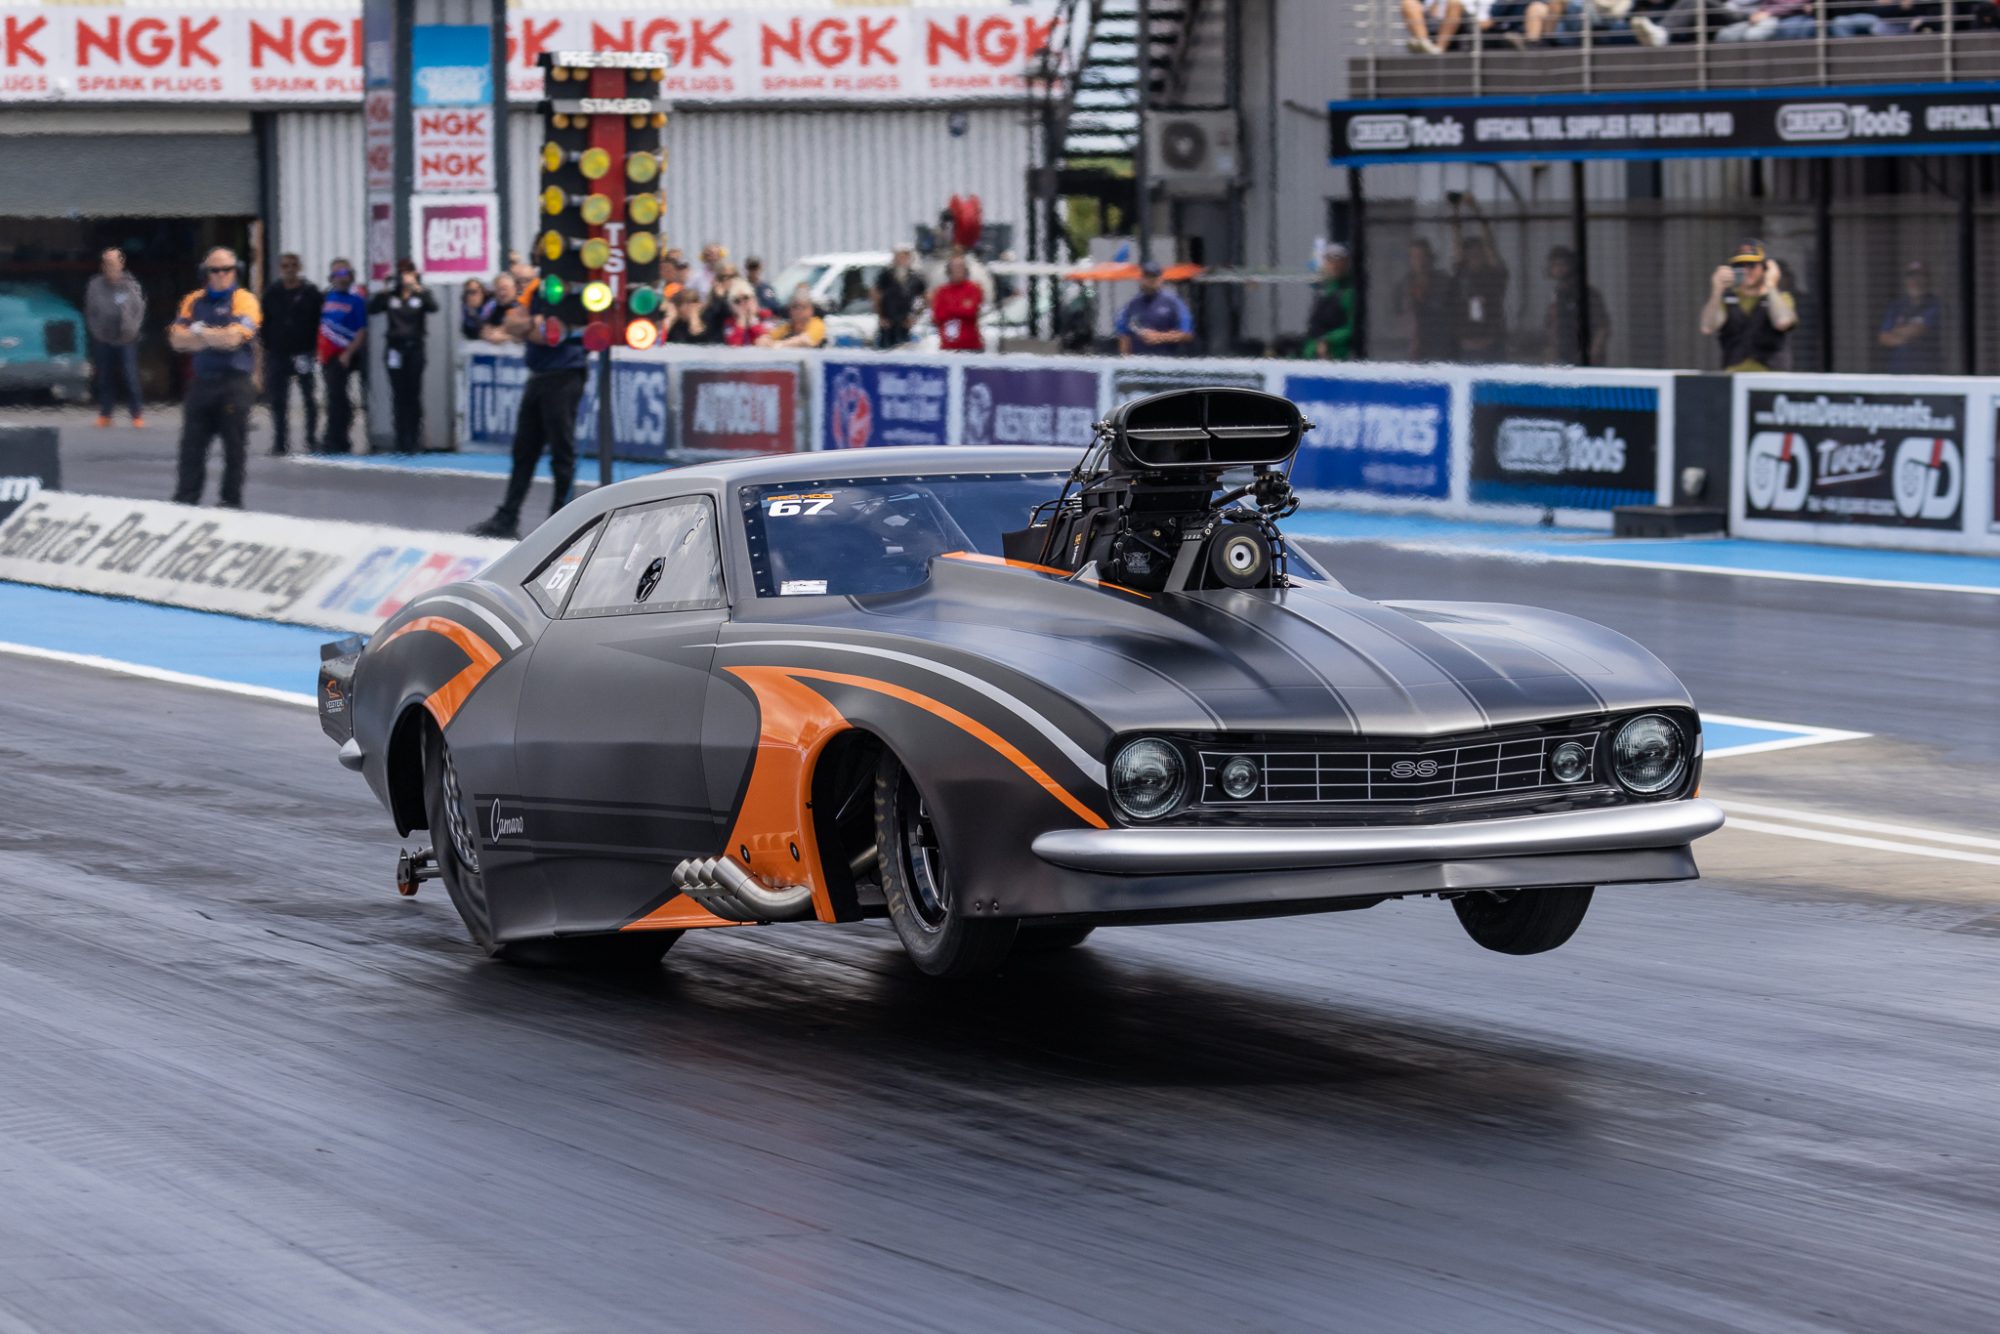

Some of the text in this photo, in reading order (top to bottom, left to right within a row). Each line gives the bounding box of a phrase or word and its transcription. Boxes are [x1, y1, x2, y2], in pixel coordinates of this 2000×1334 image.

[4, 16, 47, 67] K
[77, 16, 220, 68] NGK
[591, 18, 732, 68] NGK
[761, 16, 898, 67] NGK
[926, 15, 1063, 67] NGK
[559, 51, 668, 68] PRE-STAGED
[77, 76, 223, 91] SPARK PLUGS
[251, 77, 317, 92] SPARK
[762, 75, 899, 91] SPARK PLUGS
[580, 98, 651, 113] STAGED
[1850, 103, 1912, 136] Tools
[1925, 104, 1990, 131] OFFICIAL
[420, 112, 485, 136] NGK
[1409, 115, 1465, 146] Tools
[1475, 117, 1530, 141] OFFICIAL
[1566, 115, 1626, 139] SUPPLIER
[1659, 112, 1701, 138] SANTA
[421, 153, 486, 176] NGK
[1565, 423, 1627, 473] Tools
[768, 499, 834, 517] 67
[0, 502, 101, 565] Santa
[75, 511, 190, 574] Pod
[146, 521, 344, 613] Raceway
[1391, 760, 1438, 778] SS
[490, 798, 524, 843] Camaro
